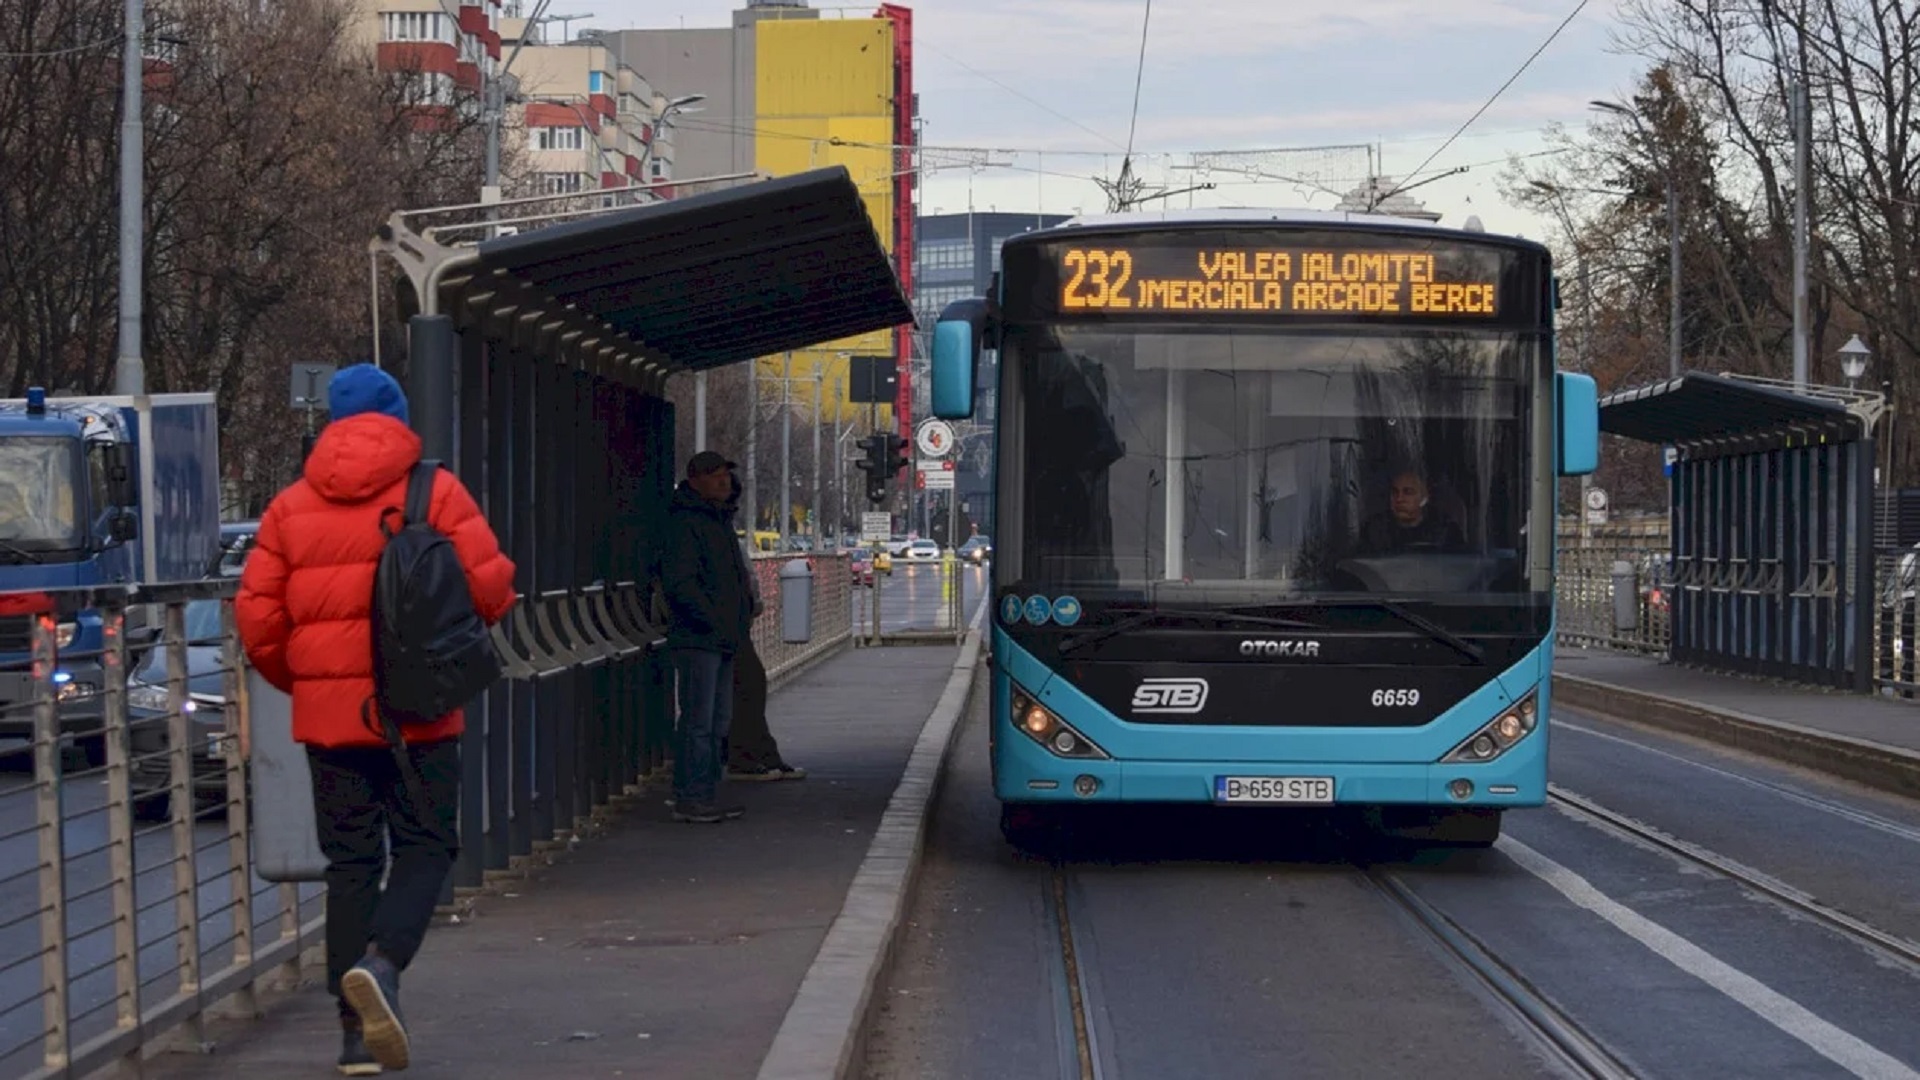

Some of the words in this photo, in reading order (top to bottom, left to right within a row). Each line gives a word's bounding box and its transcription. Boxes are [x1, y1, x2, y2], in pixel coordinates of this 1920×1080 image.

[1063, 250, 1132, 308] 232
[1198, 252, 1290, 280] VALEA
[1302, 253, 1434, 282] IALOMITEI
[1292, 282, 1400, 311] ARCADE
[1411, 284, 1494, 312] BERCE
[1239, 640, 1320, 657] OTOKAR
[1131, 682, 1203, 708] STB
[1371, 689, 1420, 707] 6659
[1228, 780, 1241, 798] B
[1250, 780, 1284, 798] 659
[1289, 780, 1328, 799] STB
